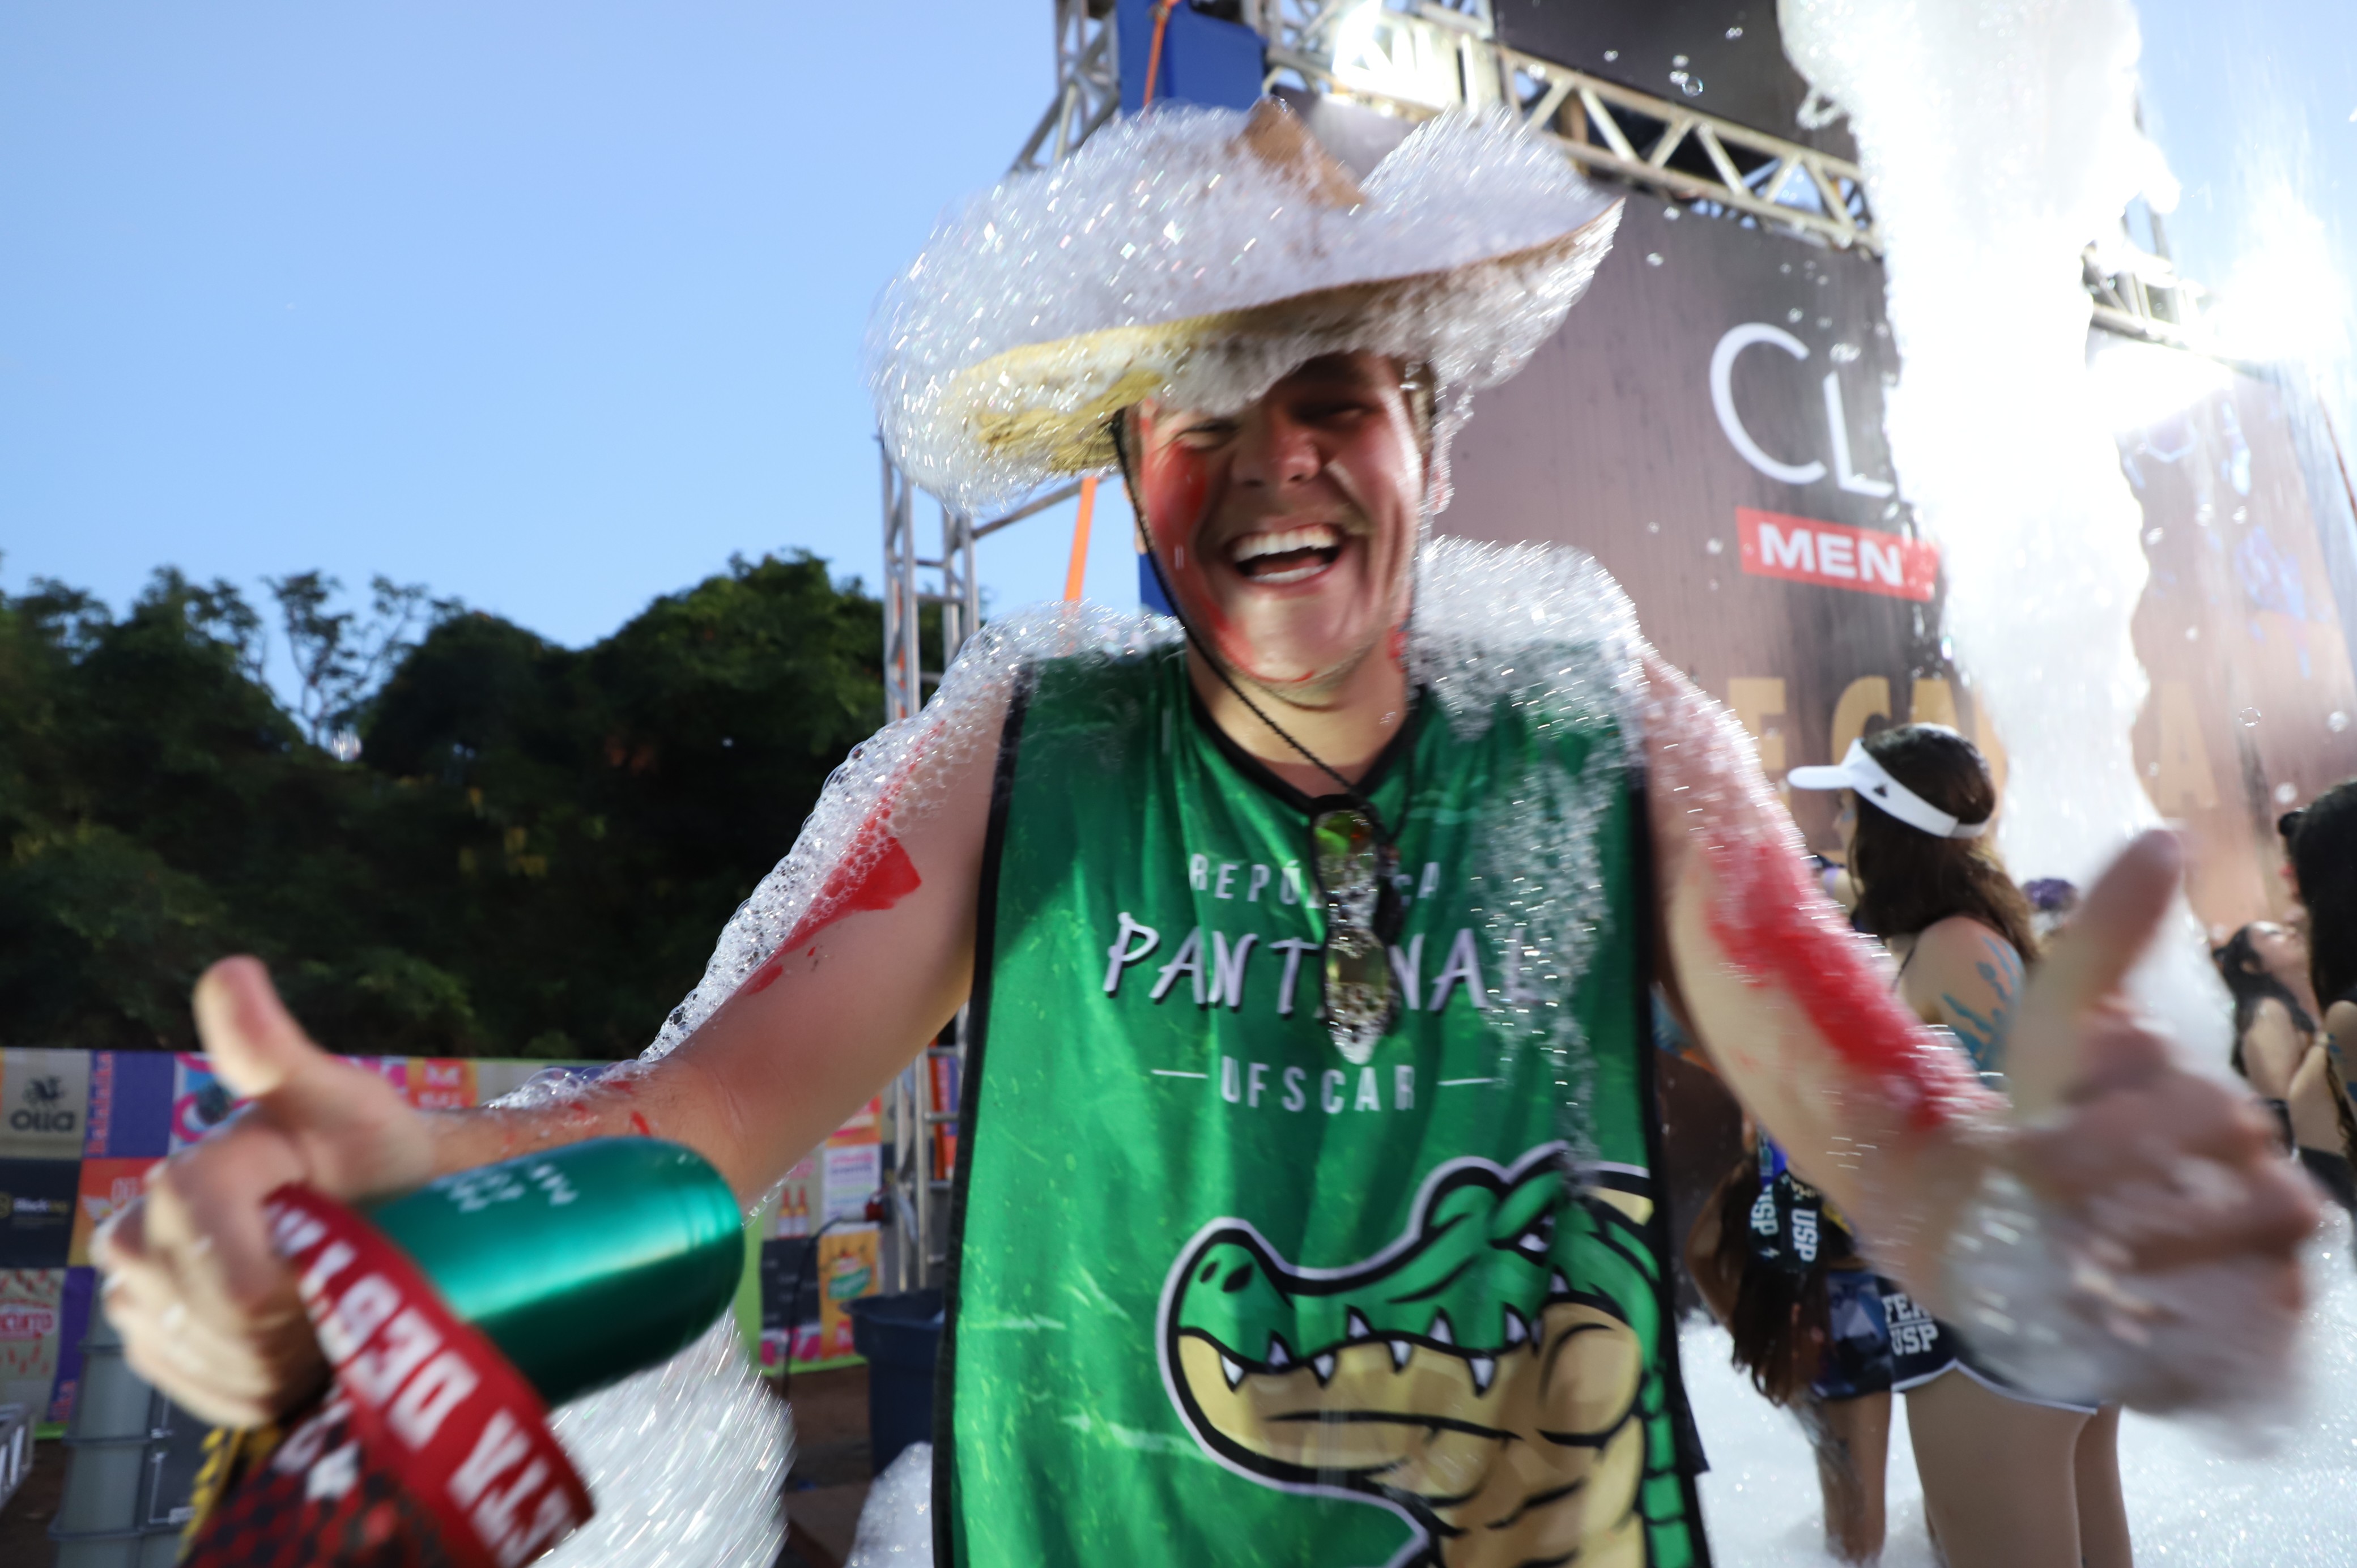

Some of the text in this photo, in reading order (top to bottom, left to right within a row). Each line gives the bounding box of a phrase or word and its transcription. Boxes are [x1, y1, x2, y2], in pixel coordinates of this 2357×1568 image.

[1758, 522, 1904, 587] MEN
[1103, 911, 1538, 1016] PANTNAL
[1220, 1056, 1416, 1115] UFSCAR
[1792, 1208, 1817, 1262] USP
[1890, 1323, 1939, 1356] USP
